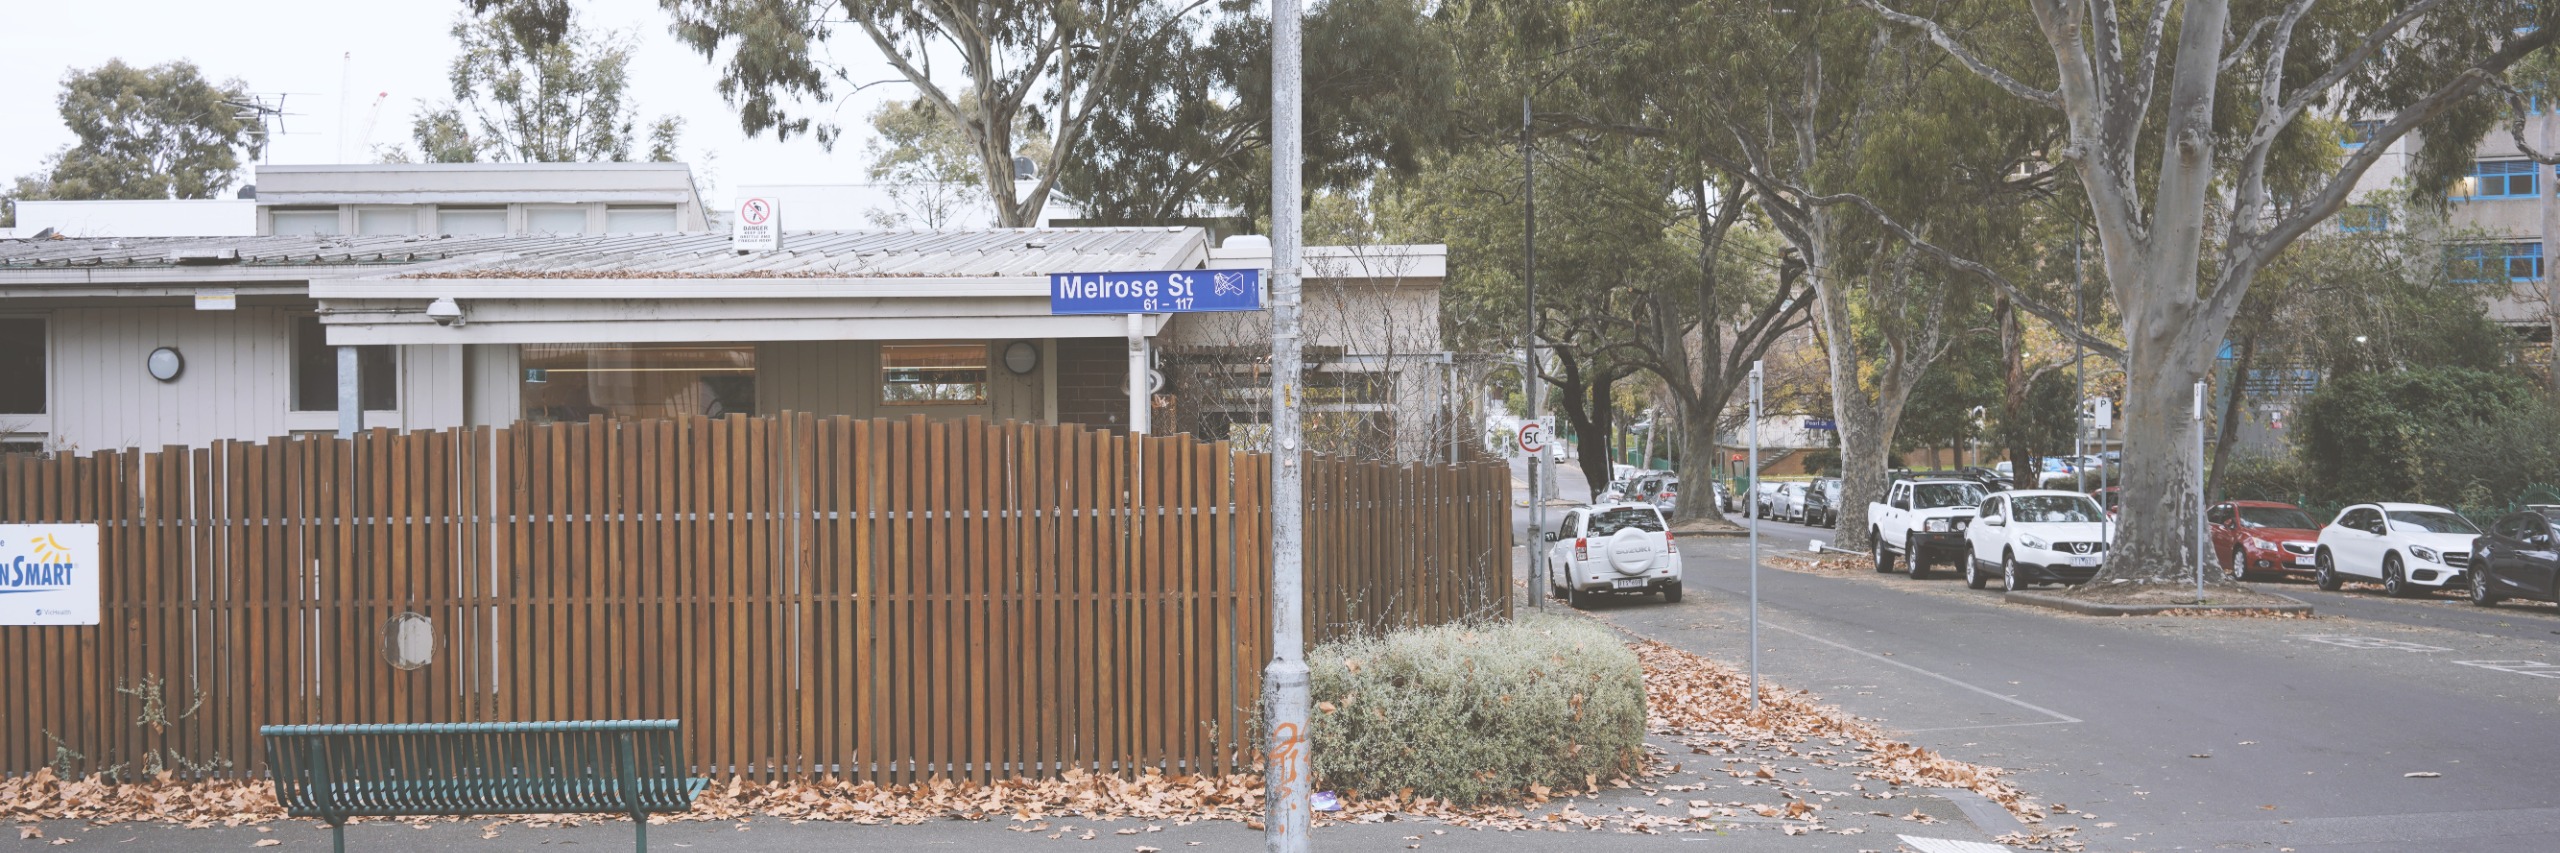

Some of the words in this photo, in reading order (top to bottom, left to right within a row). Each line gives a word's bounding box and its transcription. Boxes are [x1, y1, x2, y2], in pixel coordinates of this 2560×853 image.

[1060, 275, 1158, 299] Melrose
[1168, 273, 1194, 297] St
[1143, 297, 1158, 311] 61
[1176, 297, 1194, 310] 117
[2100, 399, 2106, 407] P
